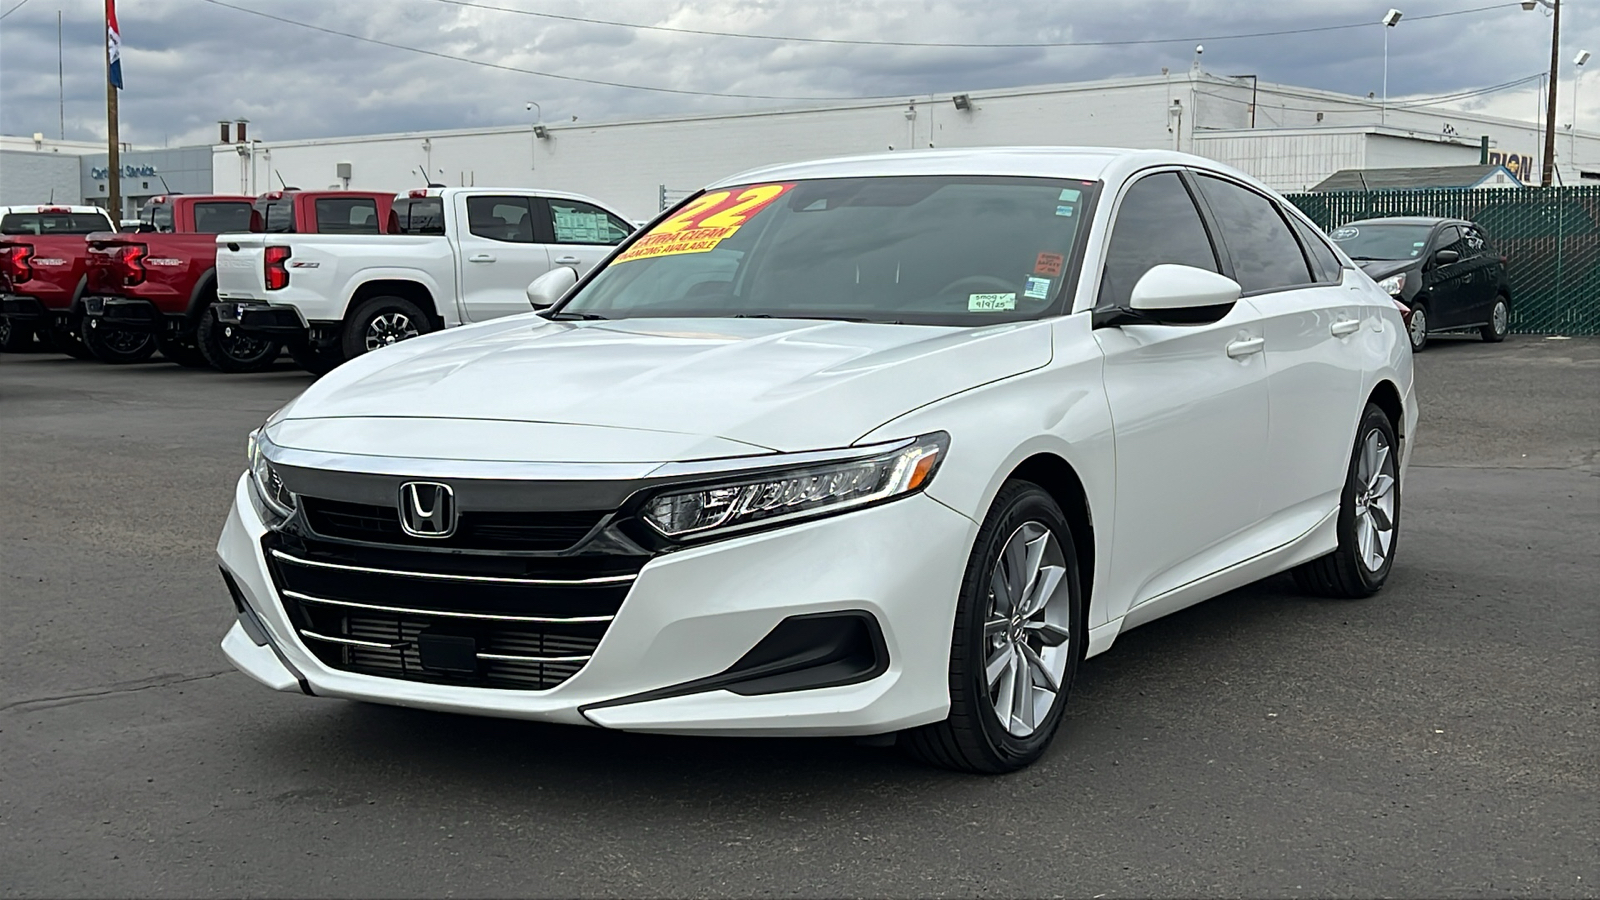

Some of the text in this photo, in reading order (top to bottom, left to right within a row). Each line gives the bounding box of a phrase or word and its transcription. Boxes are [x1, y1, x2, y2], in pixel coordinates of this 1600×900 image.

[91, 160, 126, 180] Certd
[646, 185, 783, 235] 22
[679, 226, 733, 241] CLEAN
[661, 240, 717, 253] AVAILABLE
